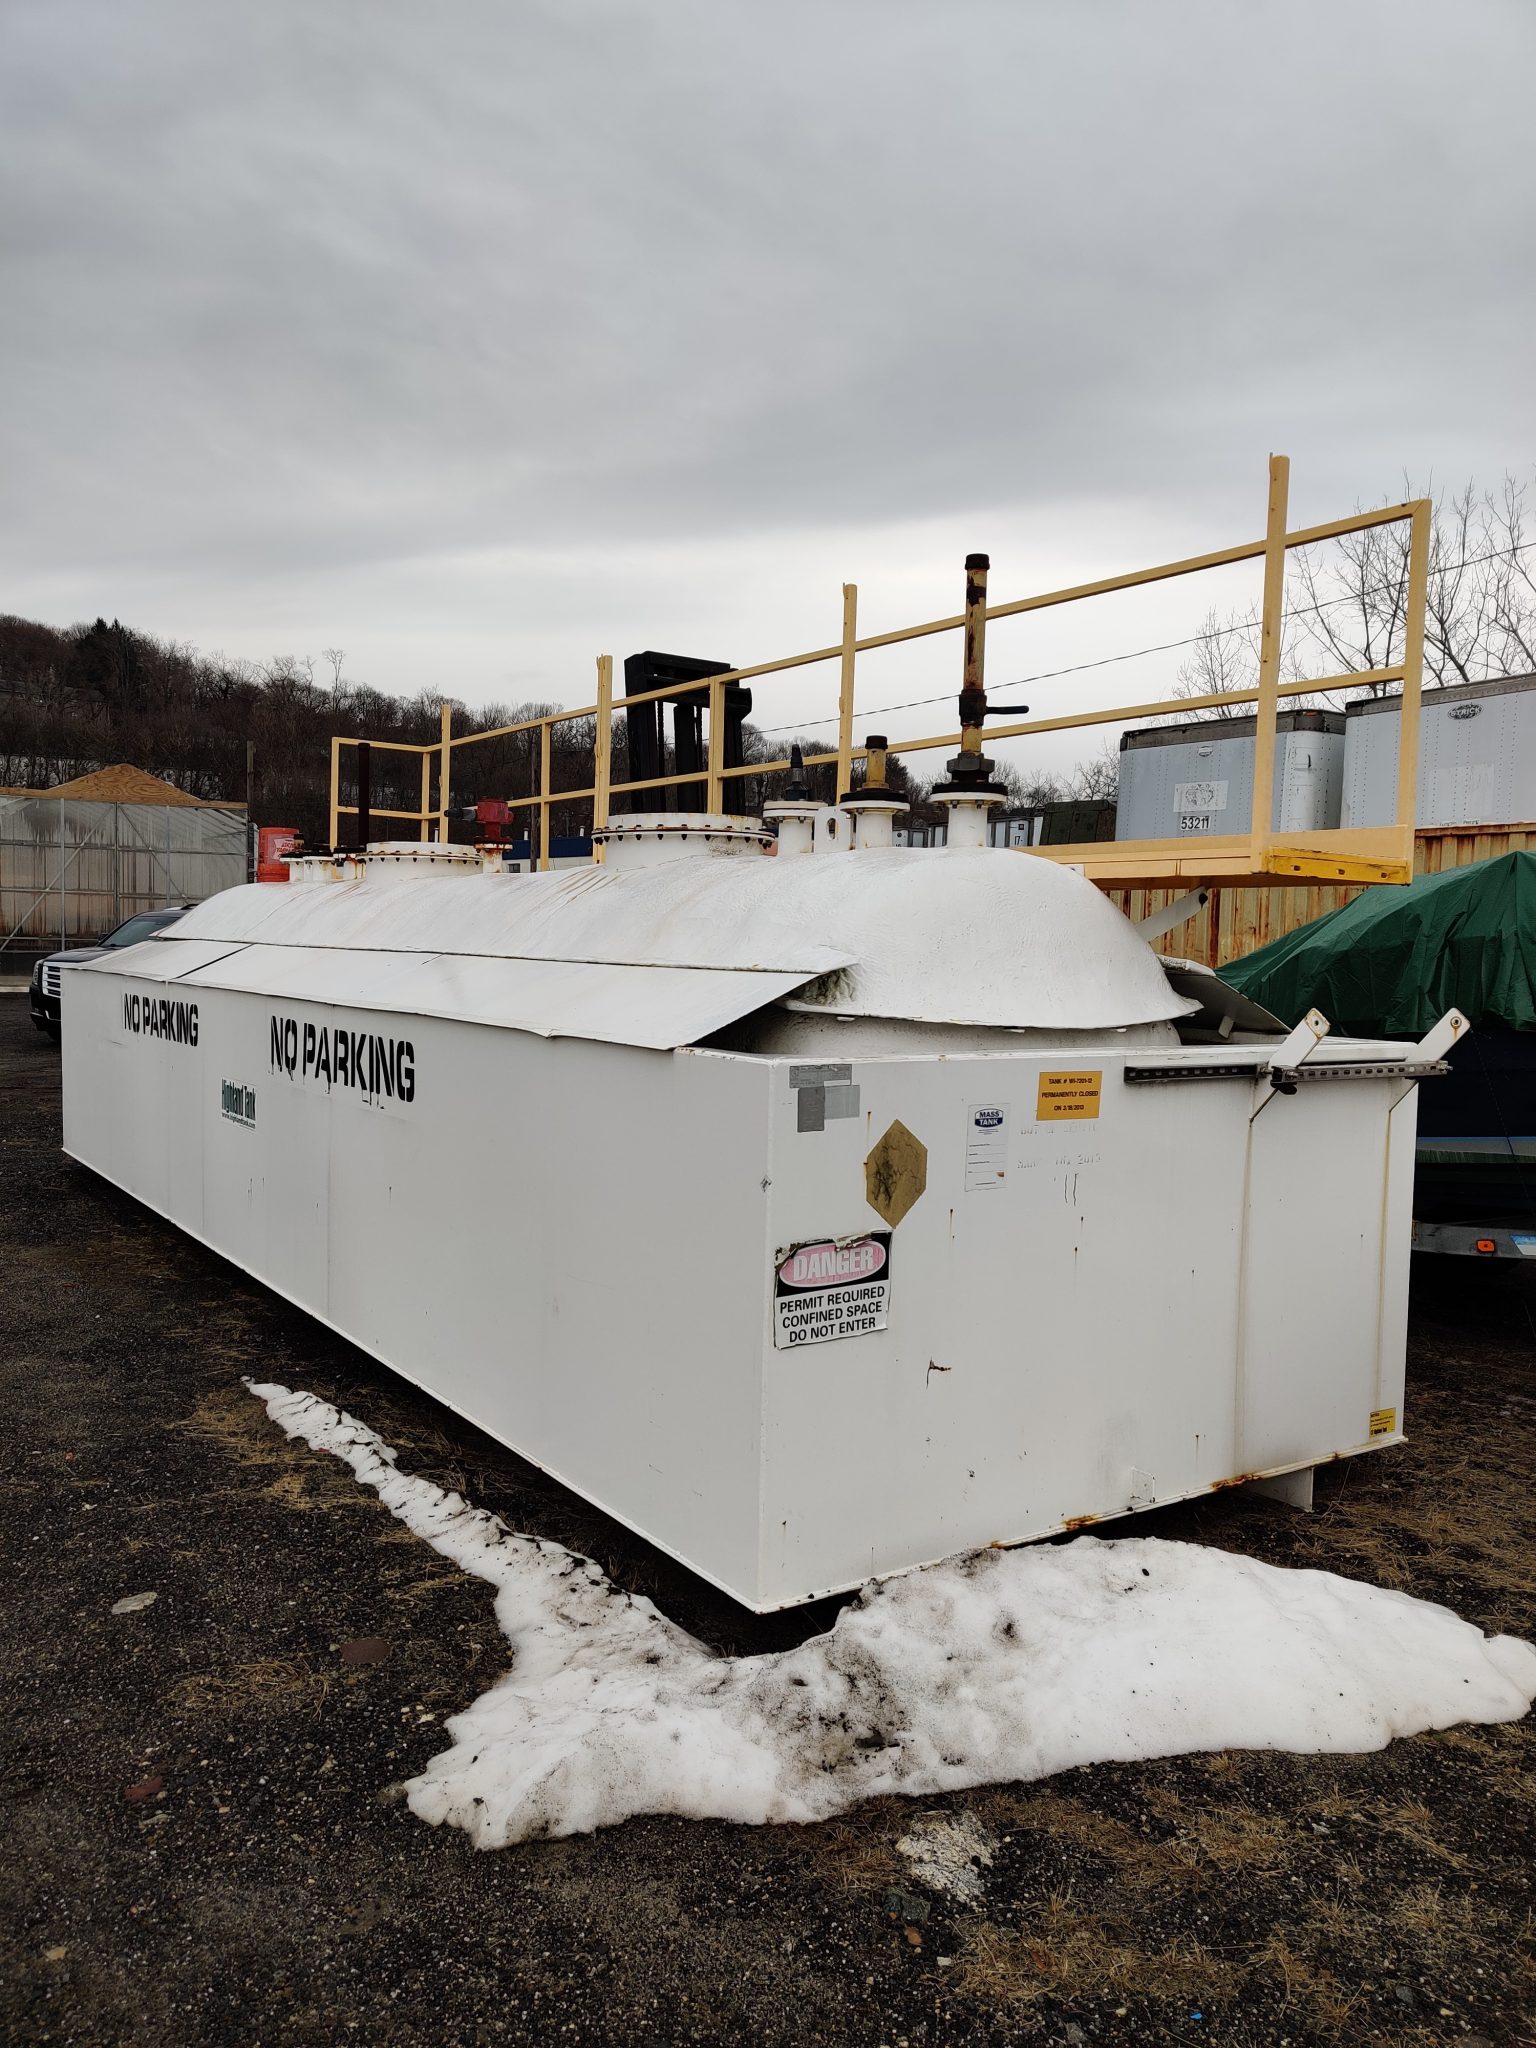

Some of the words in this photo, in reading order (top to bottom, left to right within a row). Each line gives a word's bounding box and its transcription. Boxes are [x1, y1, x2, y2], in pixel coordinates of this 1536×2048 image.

[1449, 705, 1482, 718] STRICK
[1181, 815, 1210, 830] 53211
[124, 993, 140, 1033] NO
[142, 996, 199, 1047] PARKING
[271, 1016, 298, 1073] NO
[303, 1022, 415, 1103] PARKING
[244, 1085, 256, 1121] Tank
[979, 1111, 1000, 1119] MASS
[979, 1118, 999, 1126] TANK
[793, 1246, 875, 1281] DANGER
[780, 1295, 824, 1314] PERMIT
[827, 1286, 885, 1306] REQUIRED
[782, 1308, 843, 1329] CONFINED
[846, 1301, 883, 1318] SPACE
[789, 1329, 807, 1343] DO
[810, 1323, 836, 1339] NOT
[839, 1316, 876, 1334] ENTER
